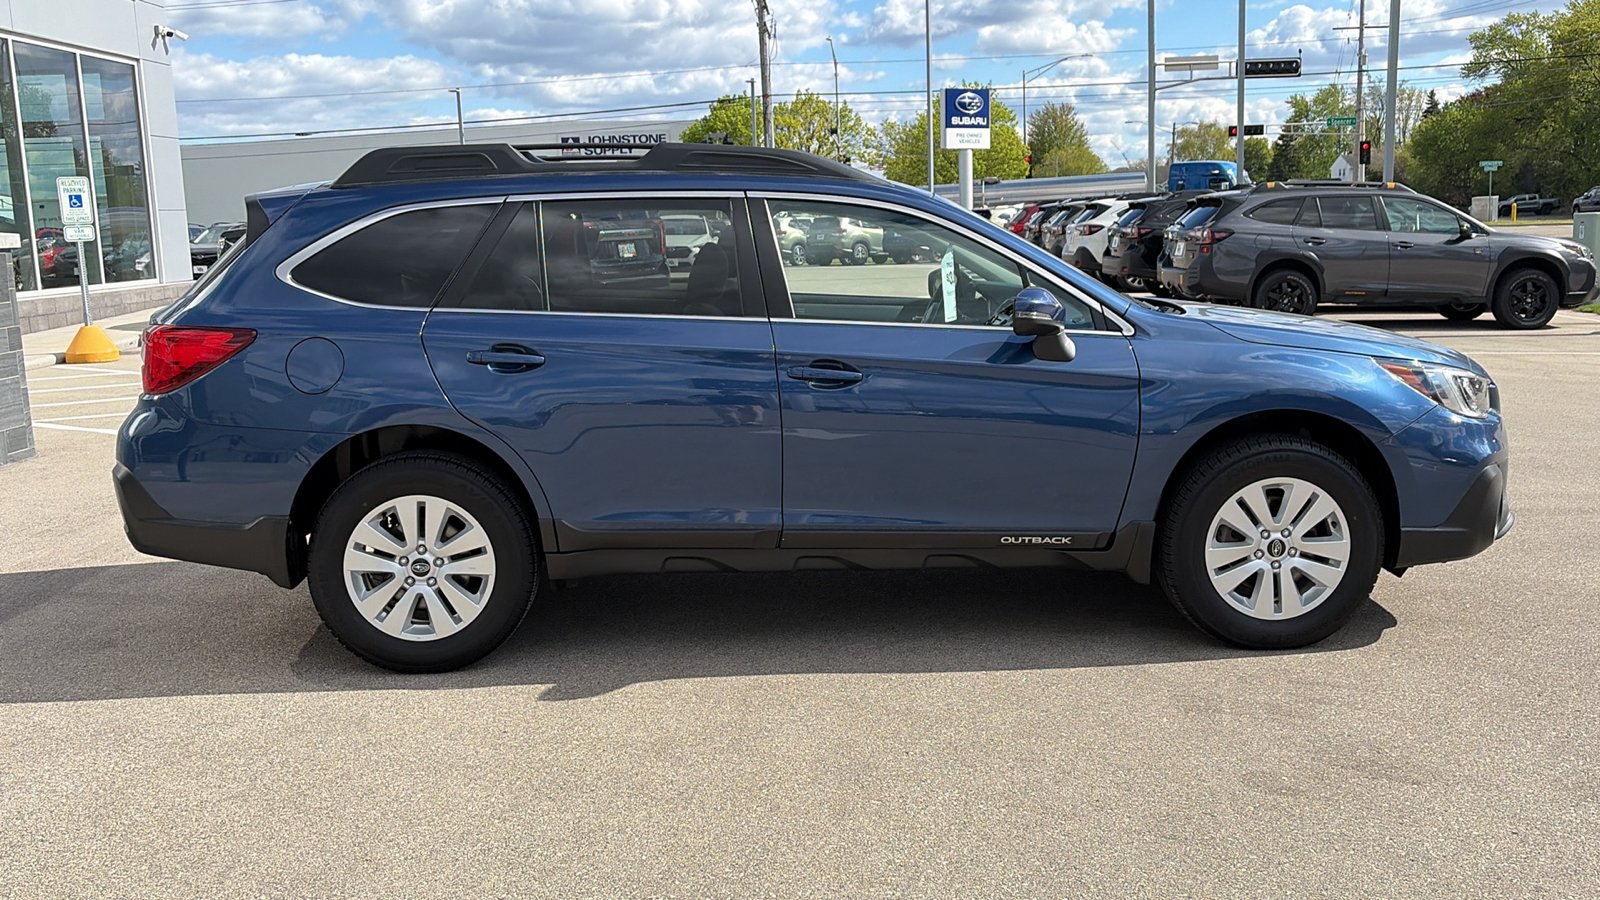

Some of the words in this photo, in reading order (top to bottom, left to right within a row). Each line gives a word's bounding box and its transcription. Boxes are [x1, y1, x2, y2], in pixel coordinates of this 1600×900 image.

[951, 116, 987, 125] SUBARU
[583, 134, 667, 143] JOHNSTONE
[1000, 536, 1072, 544] OUTBACK
